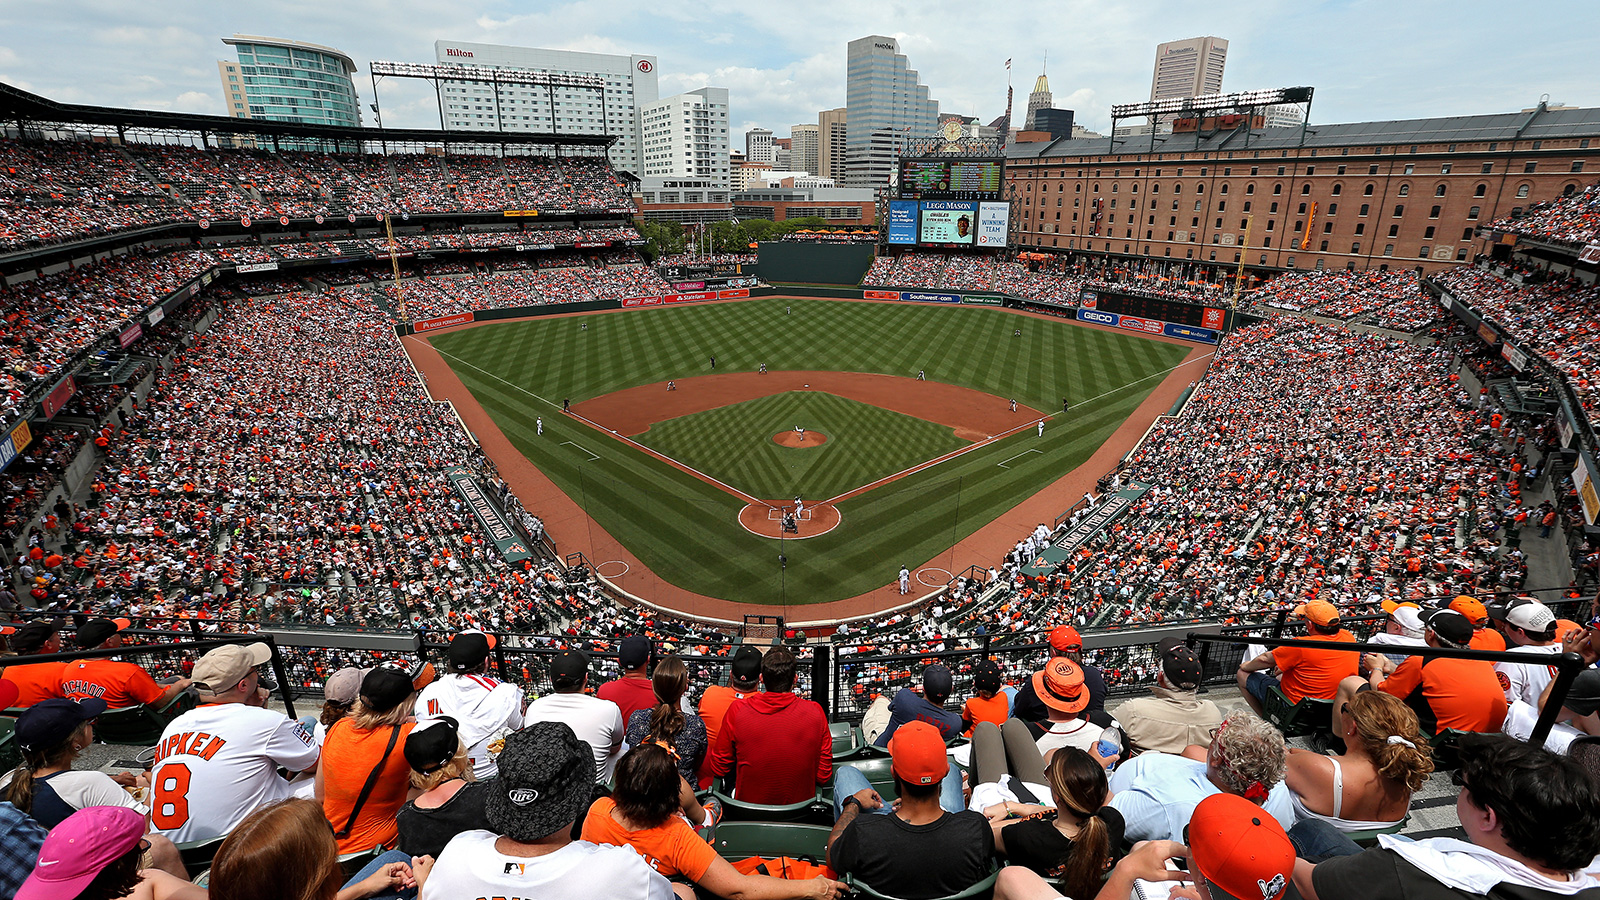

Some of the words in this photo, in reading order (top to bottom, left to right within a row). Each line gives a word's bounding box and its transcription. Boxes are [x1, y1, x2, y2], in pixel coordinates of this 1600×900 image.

[446, 48, 474, 58] Hilton
[988, 236, 1005, 244] PNC
[253, 263, 277, 271] CASINO
[1083, 311, 1113, 323] GEICO
[1, 438, 14, 462] BAY
[1057, 531, 1086, 550] HOME
[1077, 524, 1093, 534] OF
[1085, 514, 1107, 527] THE
[916, 713, 951, 737] ORTIZ
[154, 731, 227, 767] RIPKEN
[152, 763, 192, 830] 8
